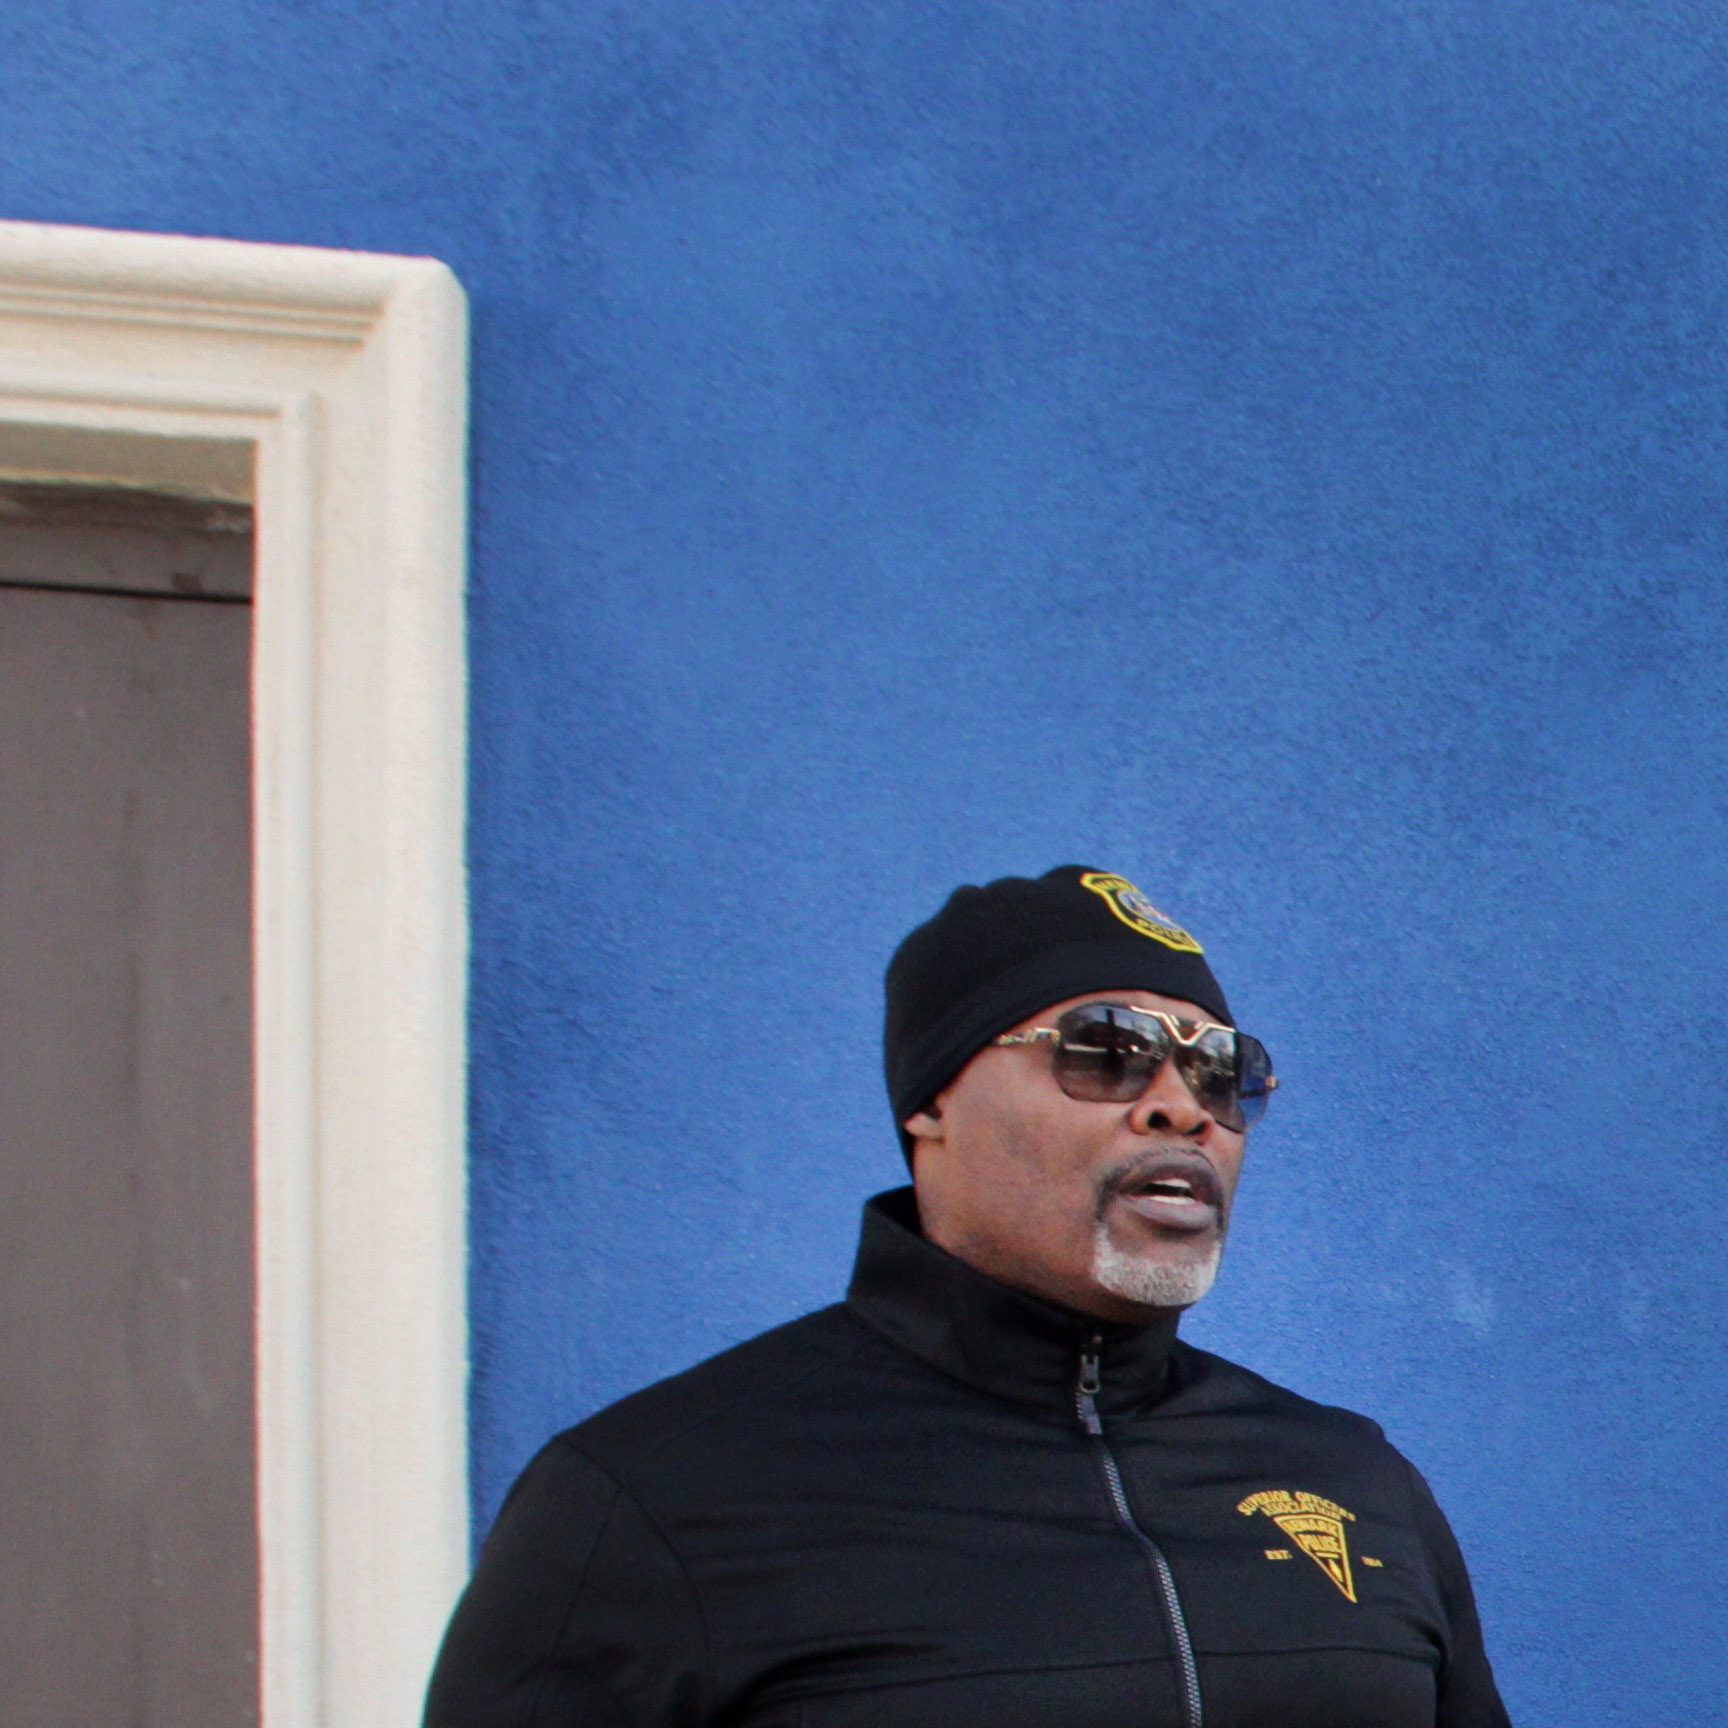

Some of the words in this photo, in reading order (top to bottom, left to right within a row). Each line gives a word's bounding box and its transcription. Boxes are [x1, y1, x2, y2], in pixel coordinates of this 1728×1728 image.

[1236, 1490, 1292, 1516] SUPERIOR
[1281, 1518, 1338, 1537] NEWARK
[1297, 1533, 1340, 1553] POLICE
[1263, 1549, 1293, 1560] EST.
